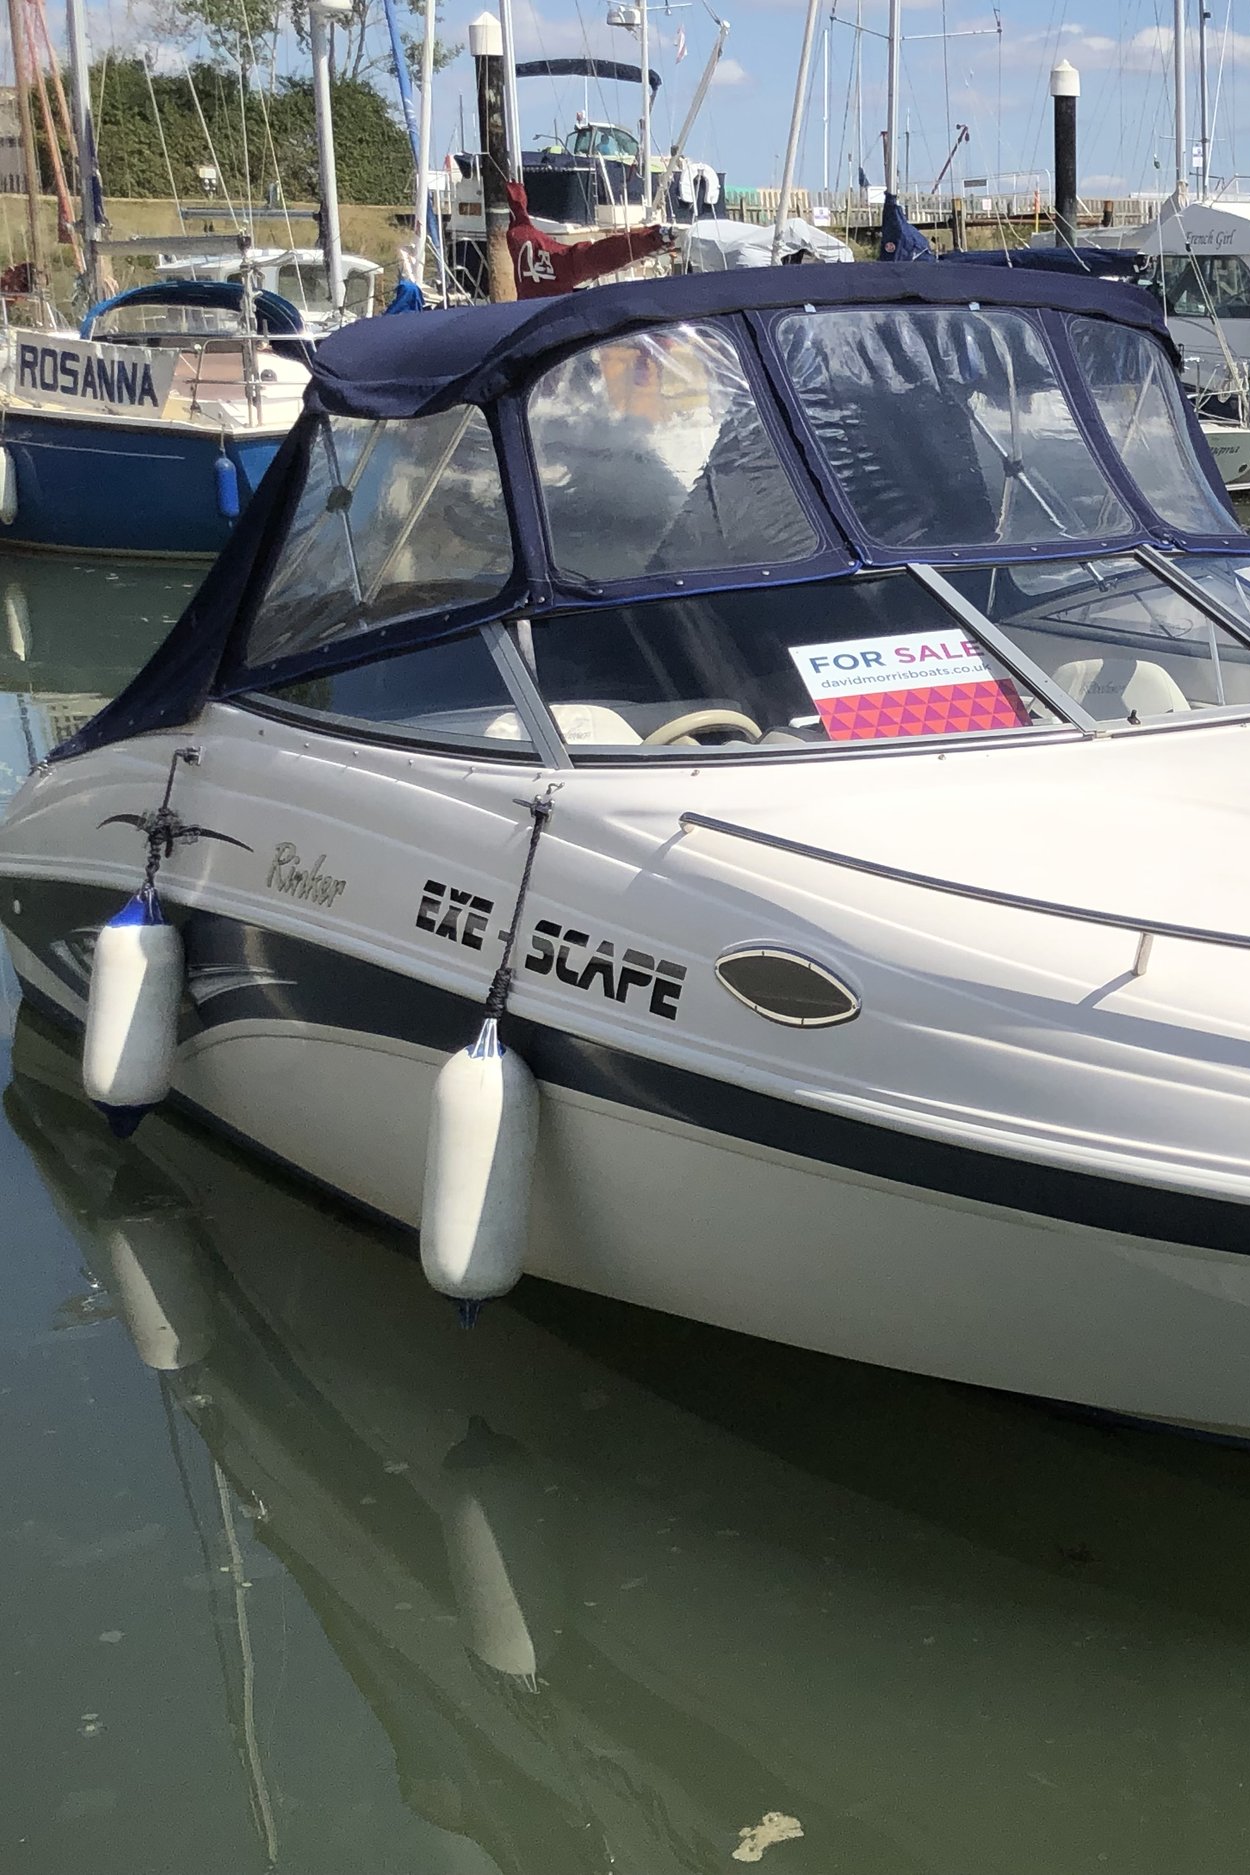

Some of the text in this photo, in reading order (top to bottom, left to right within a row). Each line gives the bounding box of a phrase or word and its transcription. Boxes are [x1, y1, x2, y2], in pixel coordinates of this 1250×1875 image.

[1216, 229, 1237, 250] Girl
[20, 343, 160, 408] ROSANNA
[808, 639, 986, 675] FOR SALE
[821, 662, 992, 689] davidmorrisboats.co.uk
[266, 841, 347, 908] Rinker
[415, 879, 495, 951] EXE
[524, 919, 688, 1022] SCAPE
